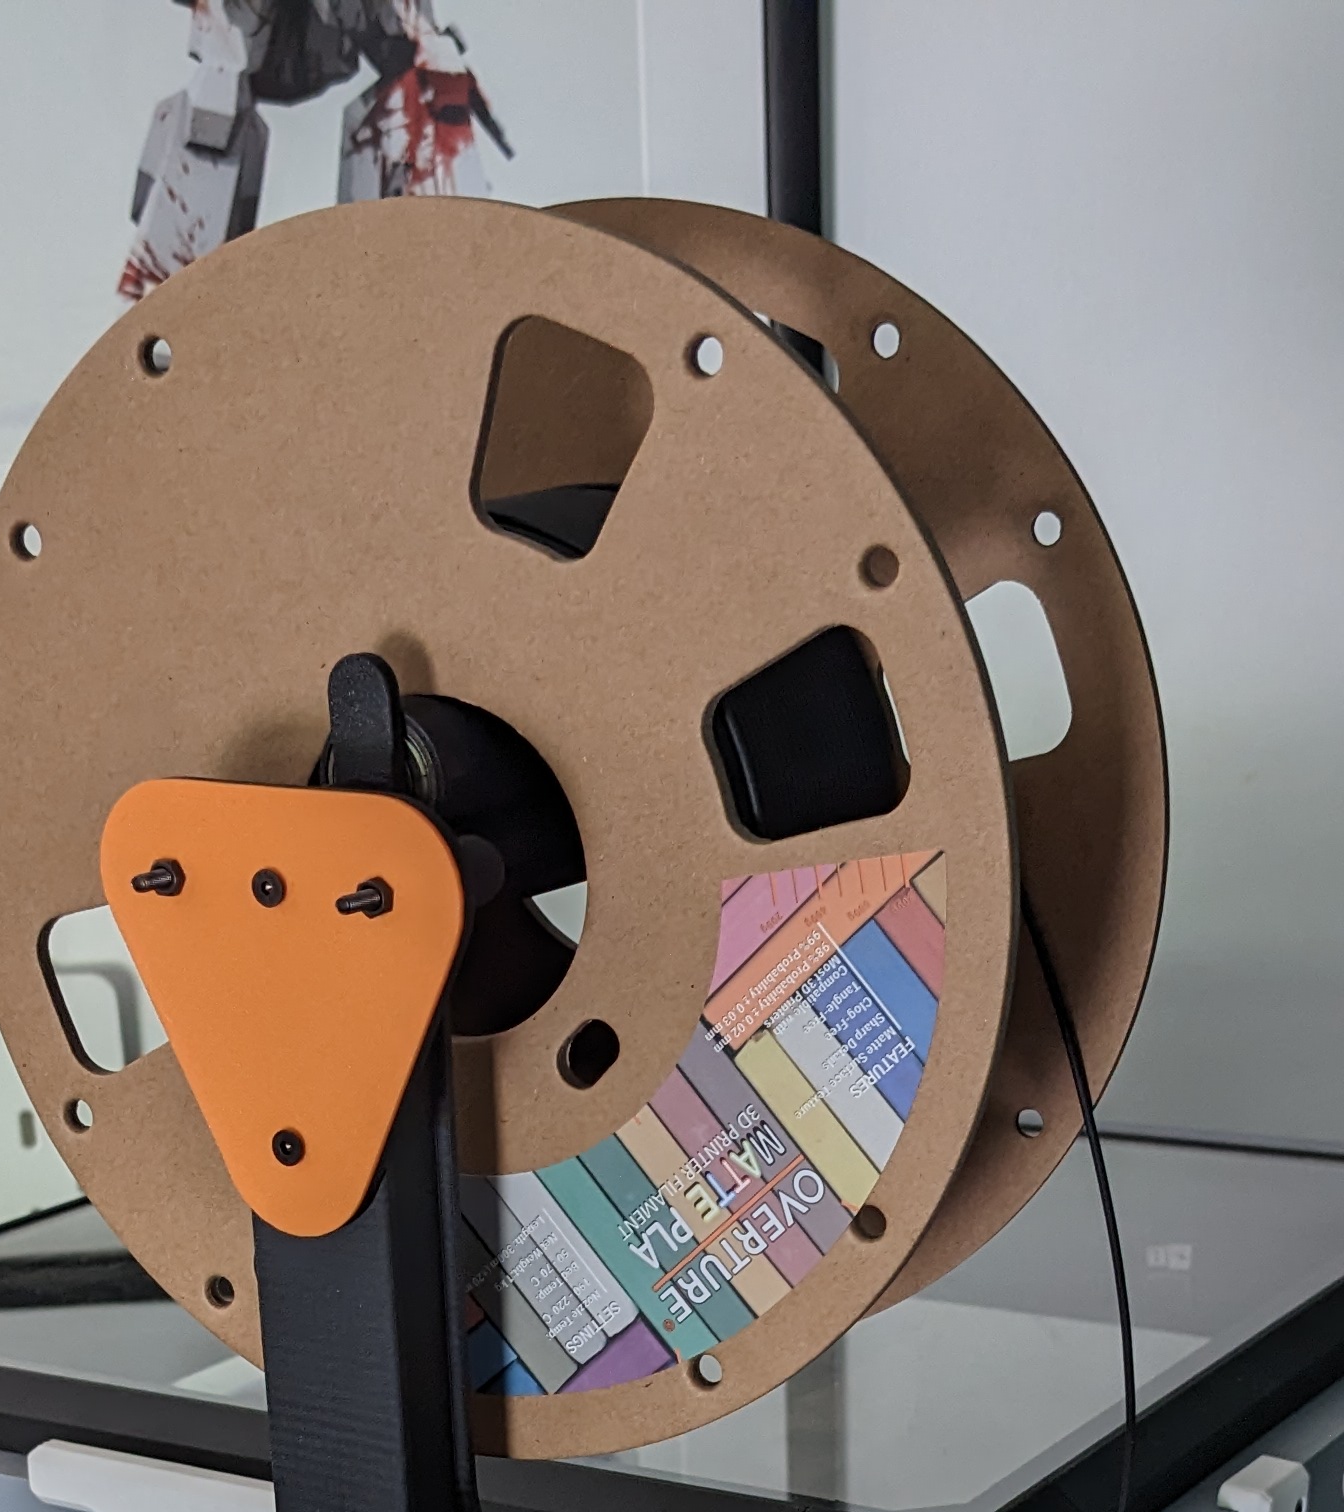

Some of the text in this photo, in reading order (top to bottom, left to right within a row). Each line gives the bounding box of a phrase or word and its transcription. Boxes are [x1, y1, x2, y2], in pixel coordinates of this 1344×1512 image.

[797, 928, 821, 952] 99%
[806, 940, 831, 964] 98%
[747, 947, 801, 998] Probability
[756, 959, 810, 1009] Probability
[762, 954, 841, 1028] Most 3D Printers
[720, 1001, 745, 1025] 0.03
[771, 964, 848, 1037] Compatible with
[801, 979, 861, 1035] Tangle-Free
[822, 995, 874, 1042] Clog-Free
[702, 1021, 722, 1042] mm
[711, 1032, 733, 1054] mm
[730, 1013, 753, 1037] 0.02
[820, 1011, 886, 1071] Sharp Details
[793, 1025, 896, 1120] Matte Surface Texture
[847, 1035, 916, 1100] FEATURES
[614, 1103, 761, 1240] 3D PRINTER FILAMENT
[627, 1121, 786, 1271] MATTE PLA
[511, 1215, 544, 1247] Length:
[539, 1231, 558, 1251] Net
[657, 1164, 830, 1324] OVERTURE
[508, 1246, 543, 1278] Weight:
[534, 1260, 579, 1302] Bed Temp:
[538, 1262, 553, 1278] 70
[544, 1289, 601, 1340] Nozzle Temp:
[550, 1294, 570, 1315] 220
[562, 1299, 621, 1354] SETTINGS
